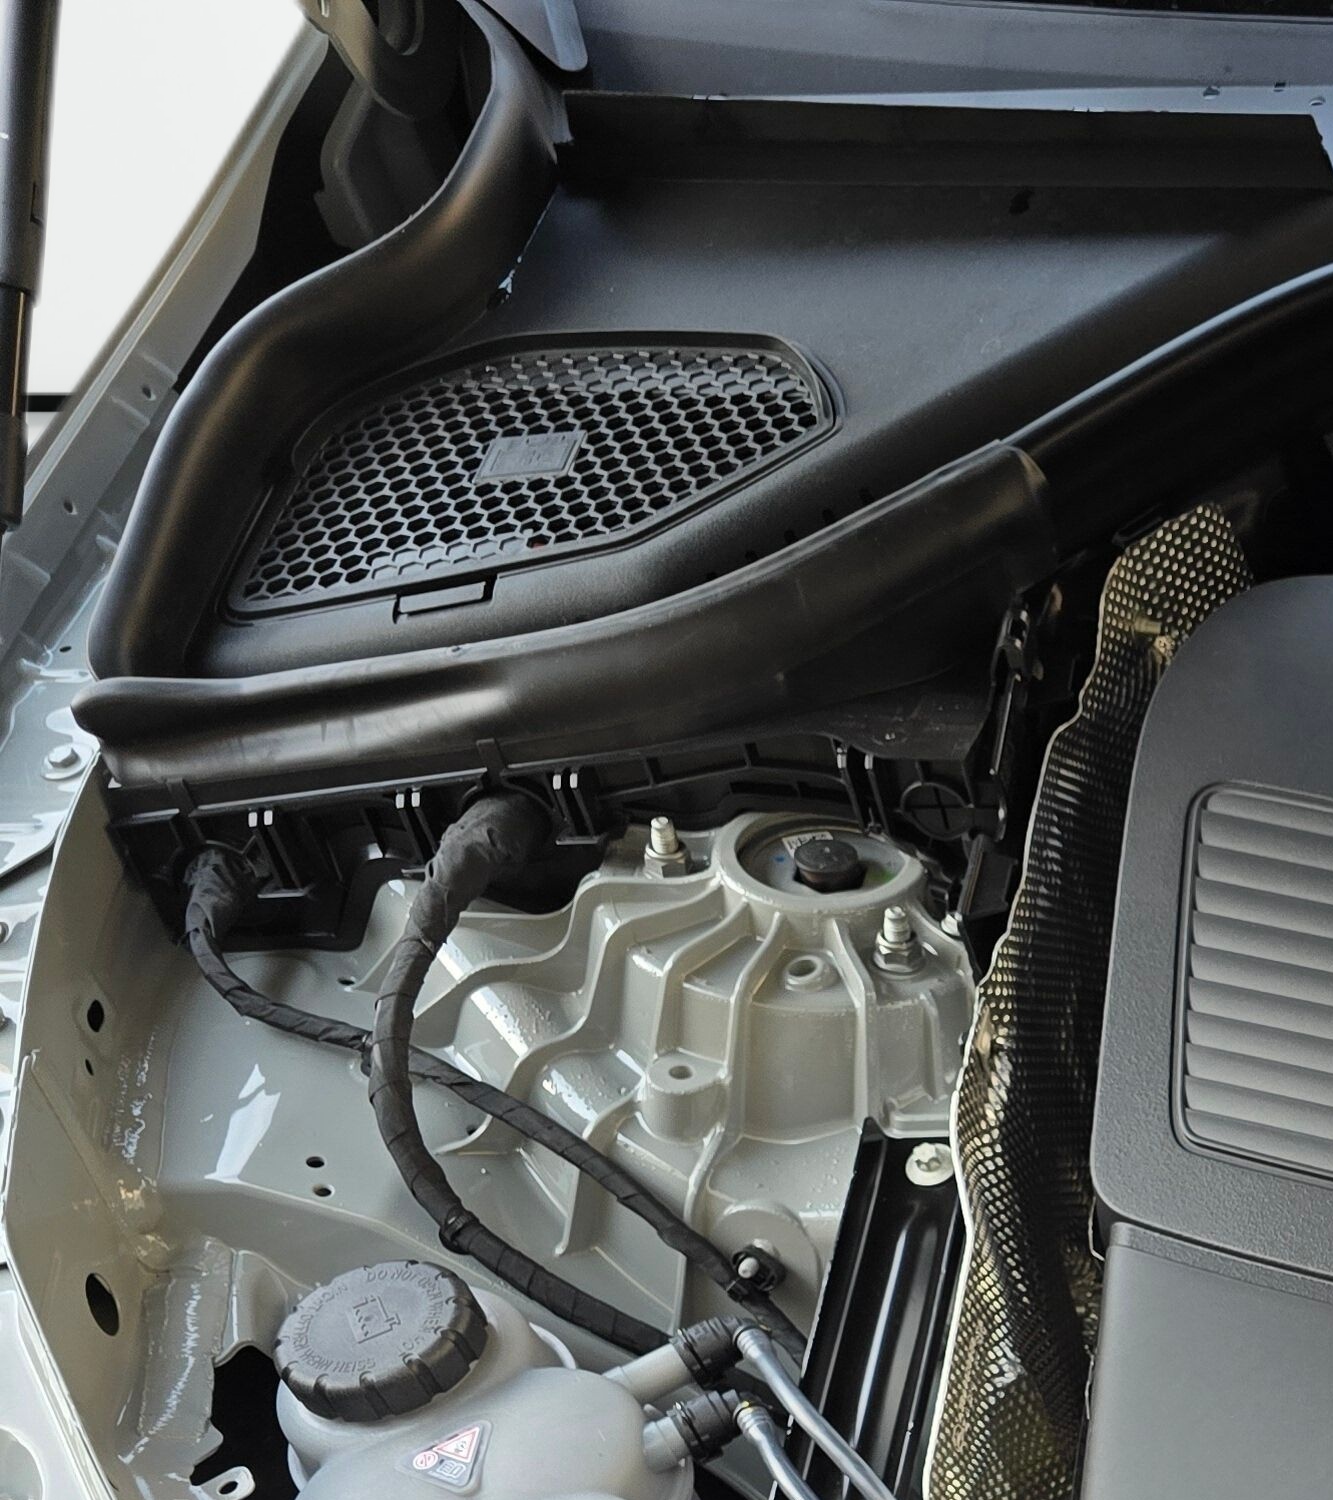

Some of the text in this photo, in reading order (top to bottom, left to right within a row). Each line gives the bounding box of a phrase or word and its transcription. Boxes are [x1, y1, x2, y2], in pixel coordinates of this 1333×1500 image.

[366, 1270, 388, 1282] DO
[391, 1269, 416, 1282] NOT
[417, 1276, 443, 1304] OPEN
[332, 1357, 376, 1373] HEISS
